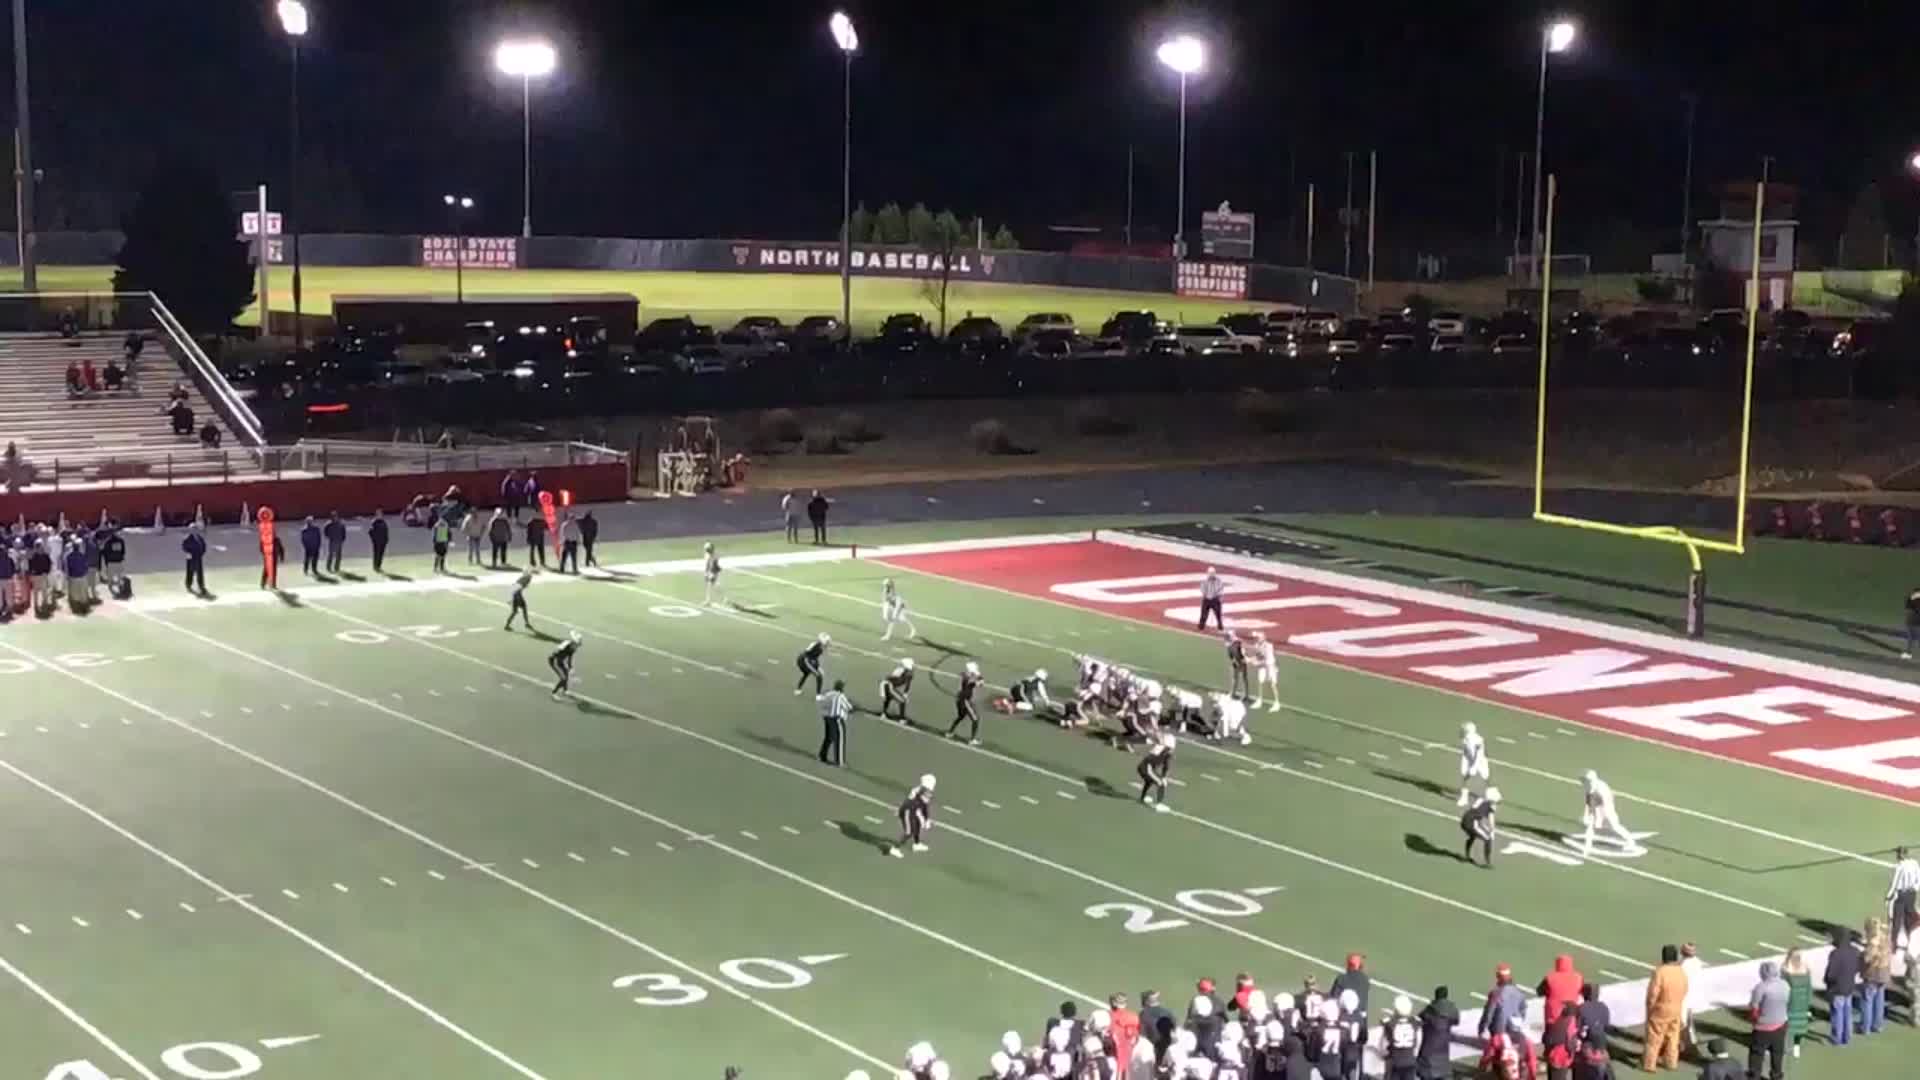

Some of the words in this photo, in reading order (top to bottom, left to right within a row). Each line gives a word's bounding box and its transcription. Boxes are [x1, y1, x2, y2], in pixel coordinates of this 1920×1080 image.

[468, 238, 516, 251] STATE
[423, 250, 516, 262] CHAMPIONS
[760, 249, 839, 266] NORTH
[851, 250, 971, 273] BASEBALL
[1209, 263, 1246, 279] STATE
[1177, 276, 1246, 293] CHAMPIONS
[1084, 887, 1265, 935] 20
[612, 957, 813, 1006] 30
